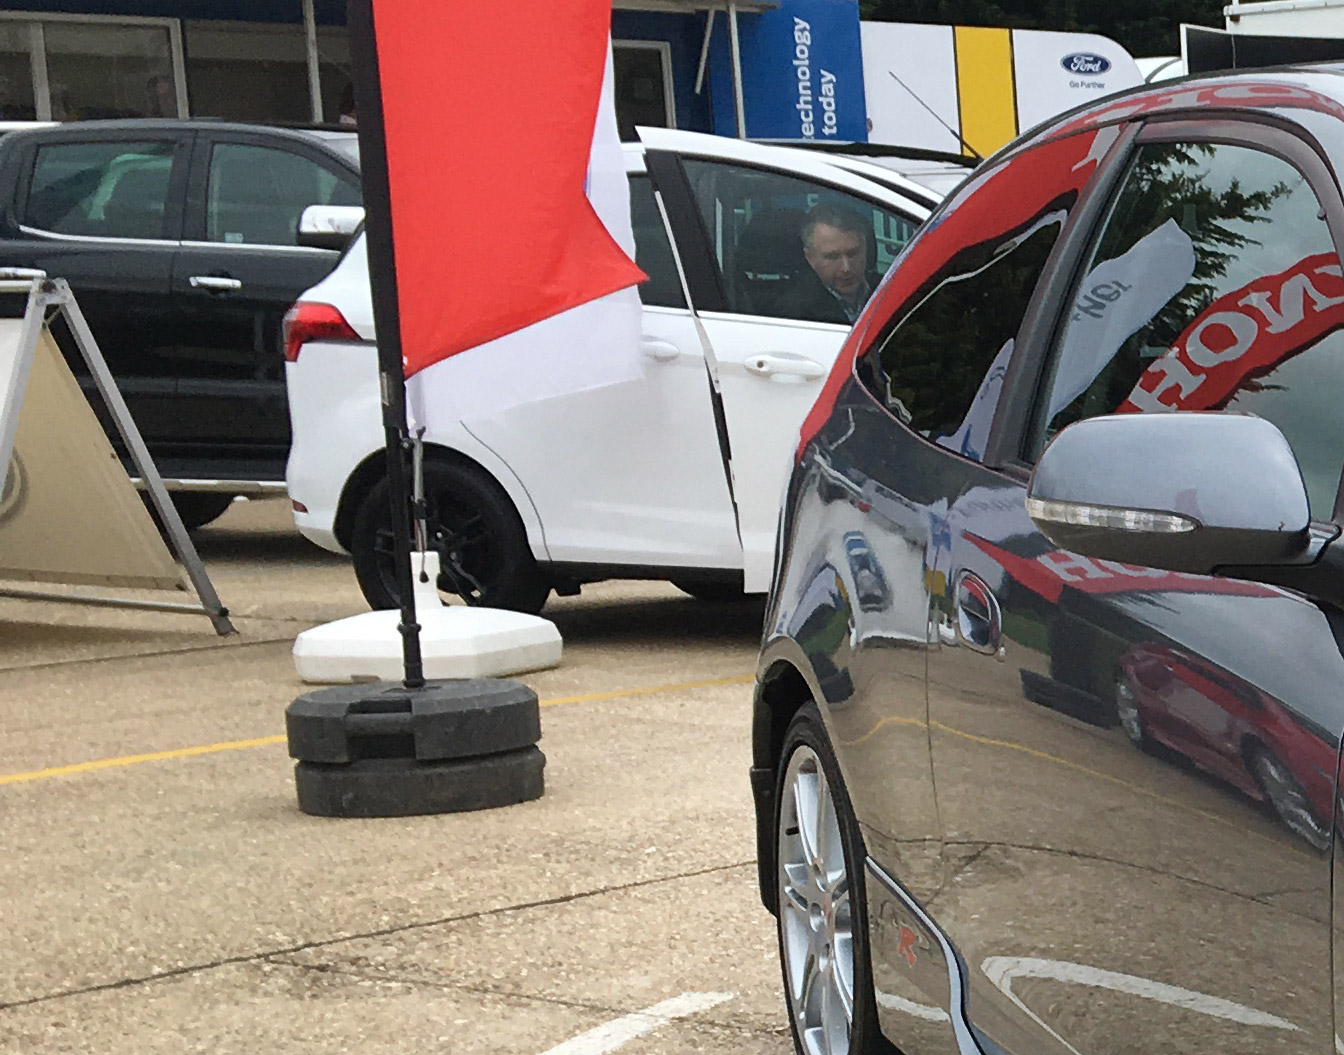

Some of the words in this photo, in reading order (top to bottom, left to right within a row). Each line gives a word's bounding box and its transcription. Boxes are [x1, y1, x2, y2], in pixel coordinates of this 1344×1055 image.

[1071, 56, 1101, 72] Ford
[1081, 81, 1105, 89] Further
[819, 69, 838, 136] today
